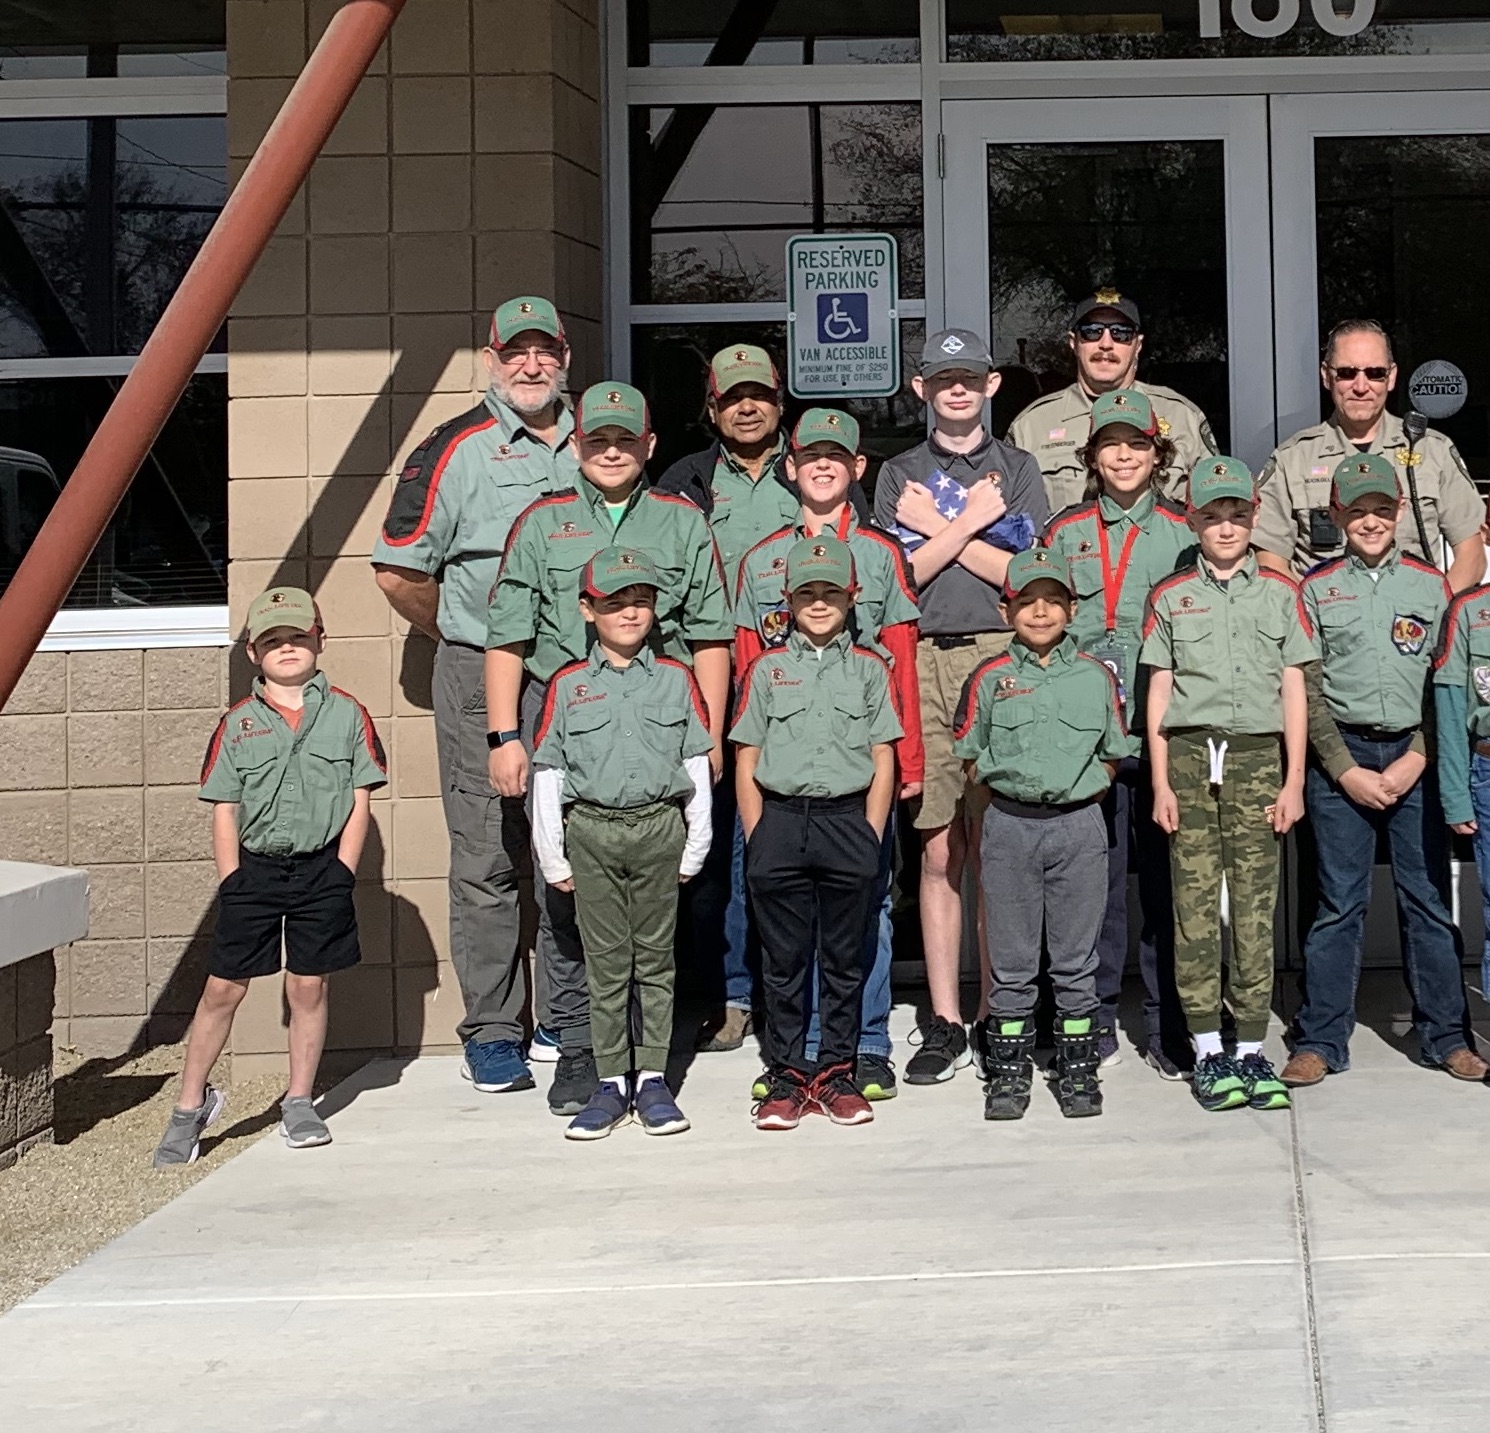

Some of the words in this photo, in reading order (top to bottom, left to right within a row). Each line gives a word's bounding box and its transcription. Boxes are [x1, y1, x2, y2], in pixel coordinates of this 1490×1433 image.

[797, 250, 885, 269] RESERVED
[805, 271, 879, 290] PARKING
[799, 348, 821, 361] VAN
[825, 346, 888, 361] ACCESSIBLE
[799, 364, 833, 373] MINIMUM
[836, 364, 853, 373] FINE
[855, 363, 866, 372] OF
[804, 374, 820, 383] FOR
[823, 374, 839, 383] USE
[841, 373, 850, 382] BY
[853, 373, 883, 382] OTHERS
